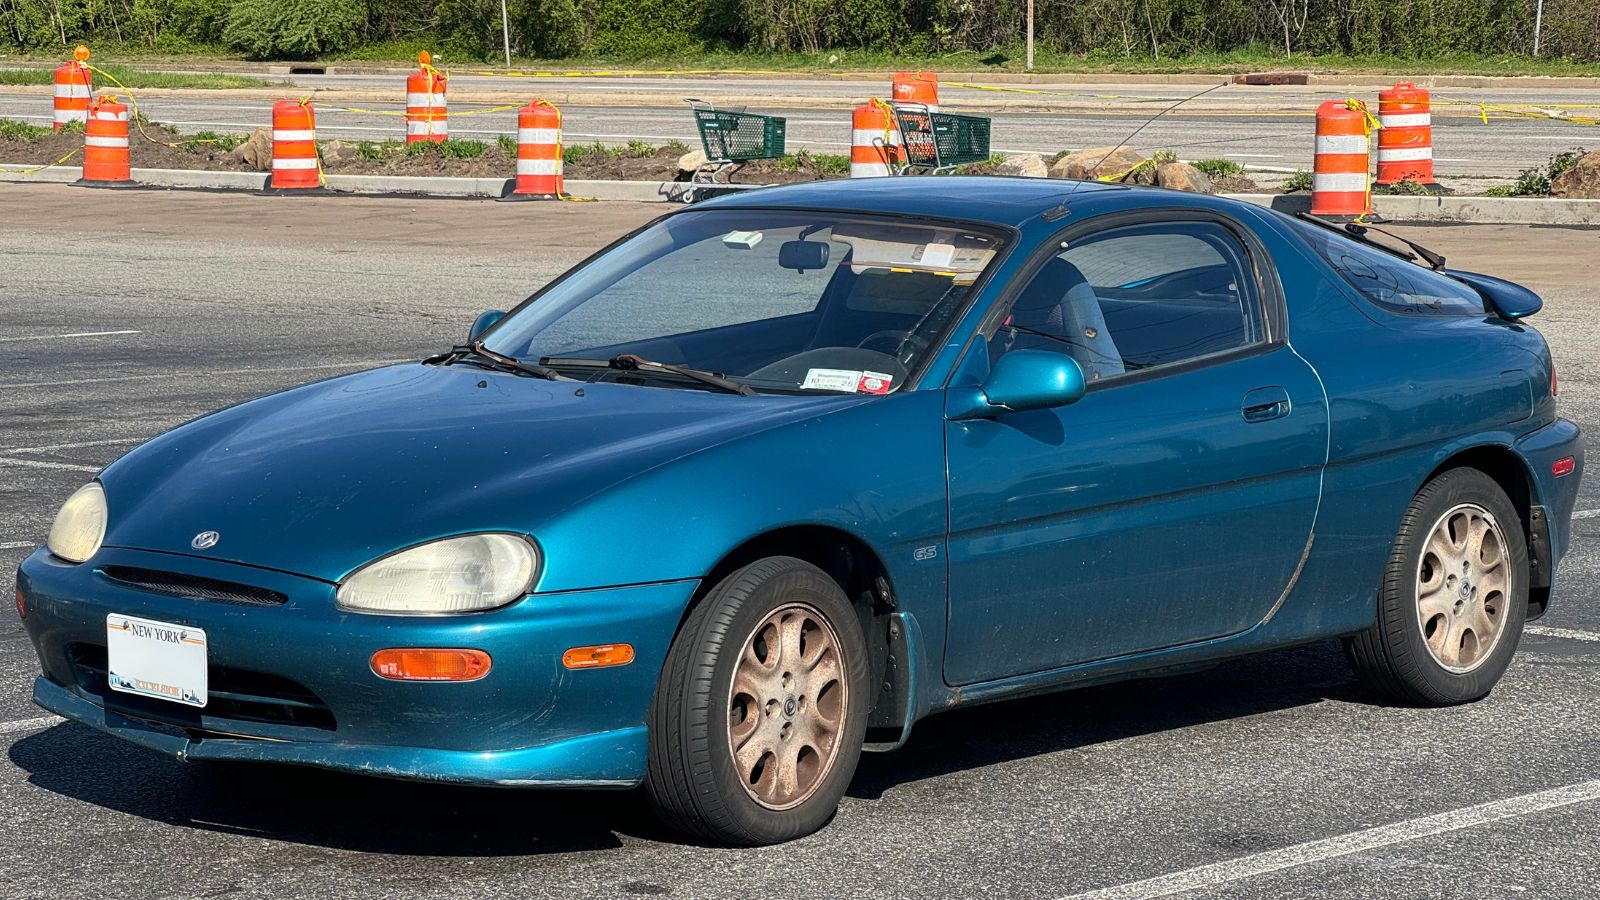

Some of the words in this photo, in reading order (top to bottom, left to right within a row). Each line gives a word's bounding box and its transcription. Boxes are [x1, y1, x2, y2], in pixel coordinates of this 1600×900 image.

[913, 545, 936, 560] GS
[132, 623, 153, 639] NEW
[154, 628, 180, 644] YORK
